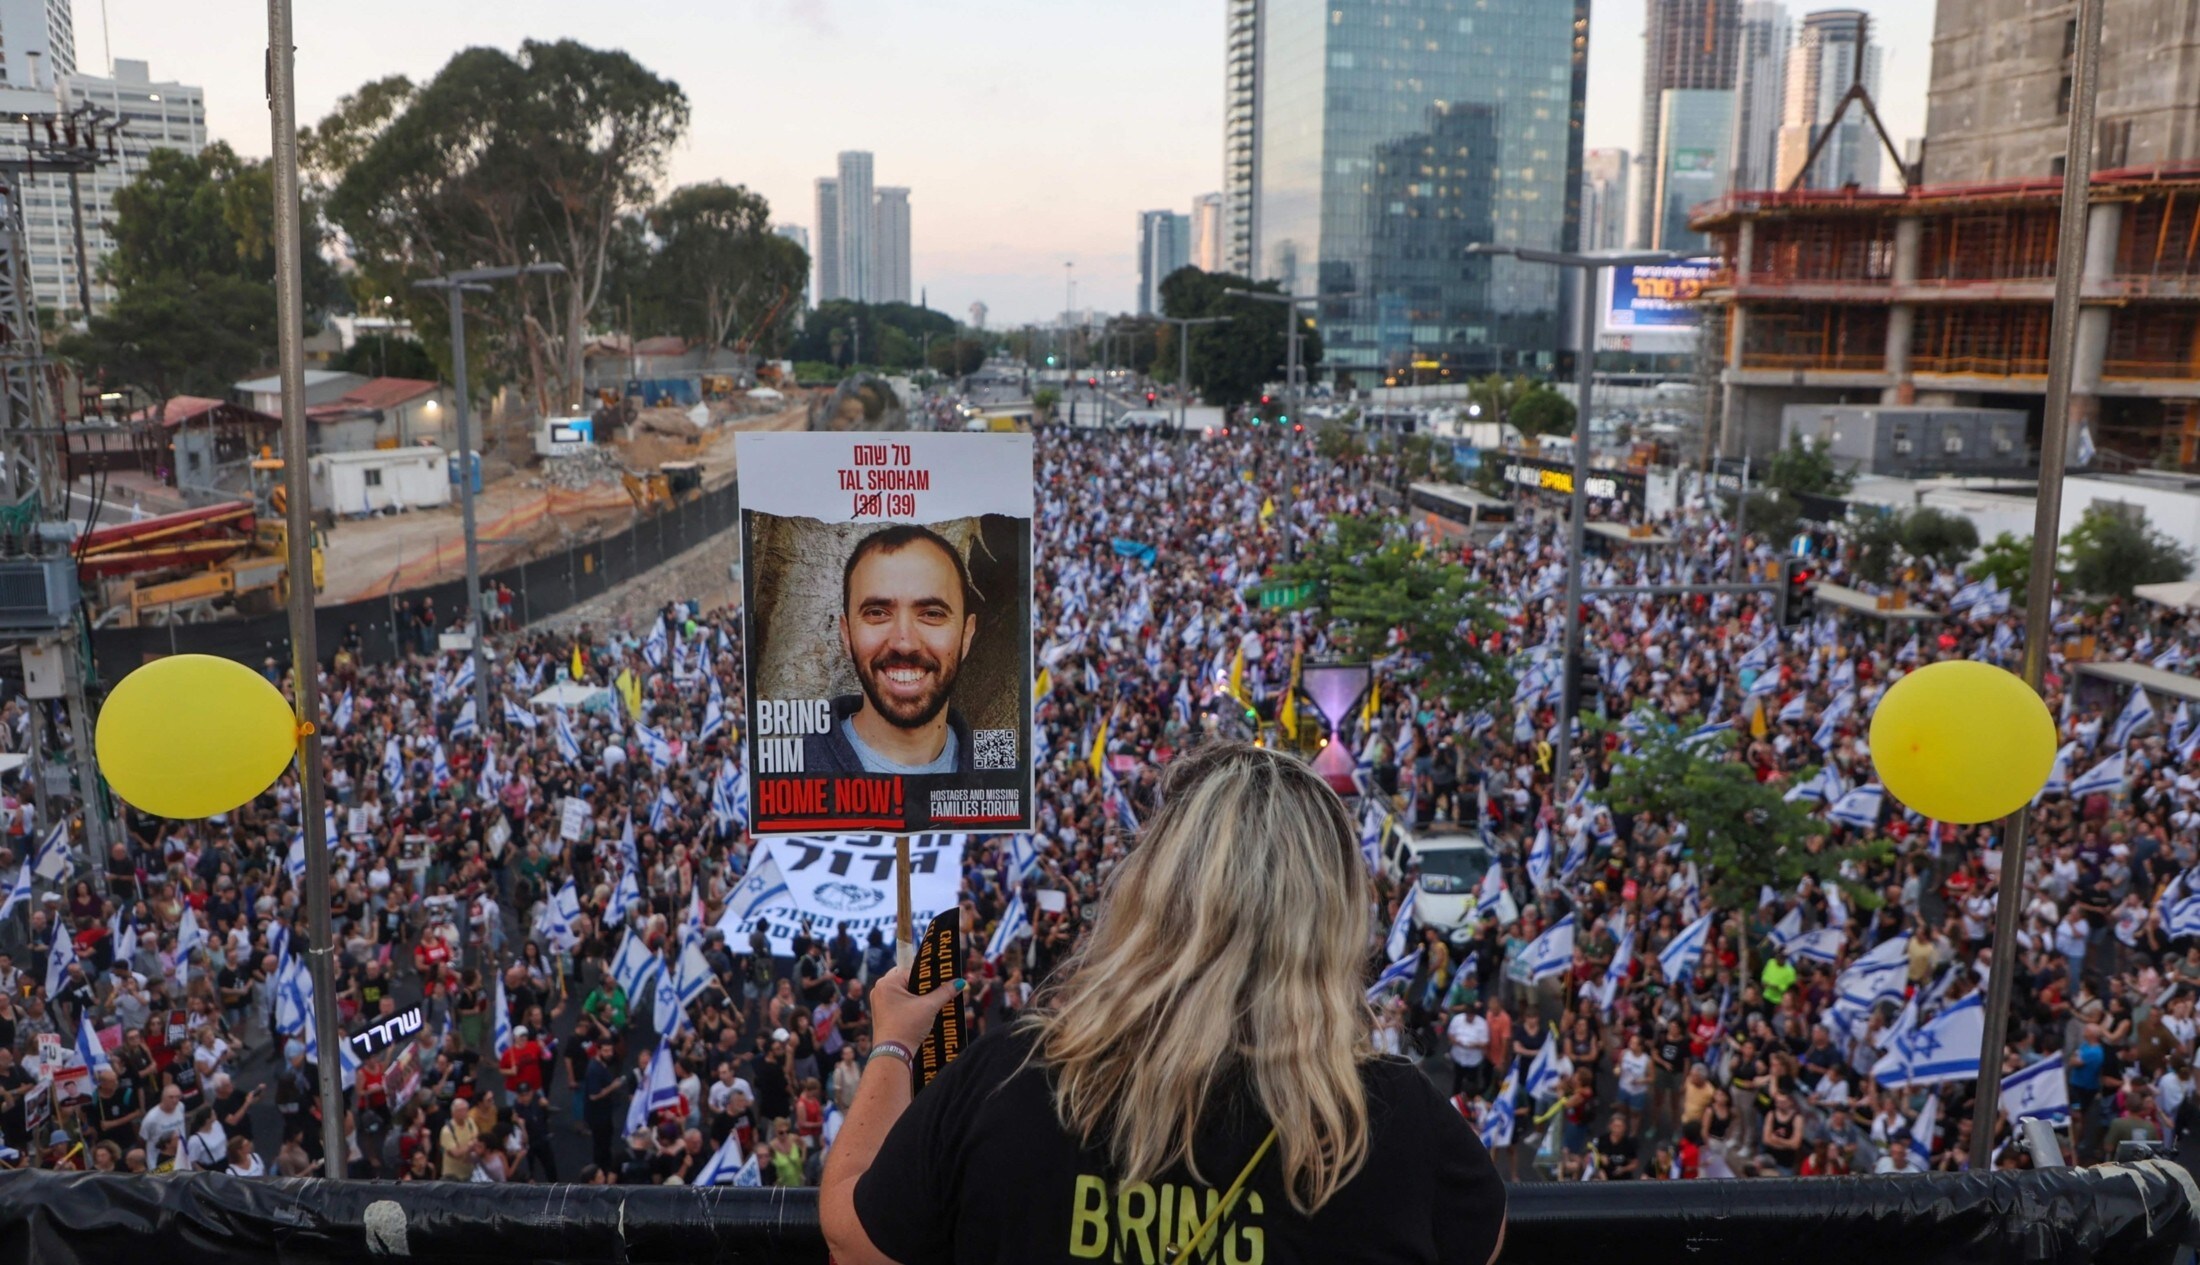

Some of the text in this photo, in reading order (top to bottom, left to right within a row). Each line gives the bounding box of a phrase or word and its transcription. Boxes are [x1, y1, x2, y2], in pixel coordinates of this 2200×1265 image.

[854, 444, 911, 466] טל שהם
[838, 470, 929, 490] TAL SHOHAM
[854, 493, 915, 517] (38) (39)
[757, 699, 831, 735] BRING
[758, 738, 804, 773] HIM
[760, 776, 904, 815] HOME NOW!
[930, 788, 1019, 801] HOSTAGES AND MISSING
[930, 800, 1019, 817] FAMILIES FORUM
[938, 930, 952, 959] כאילו
[940, 962, 953, 979] בנו
[352, 1007, 422, 1053] שחרר
[1069, 1174, 1264, 1265] BRING
